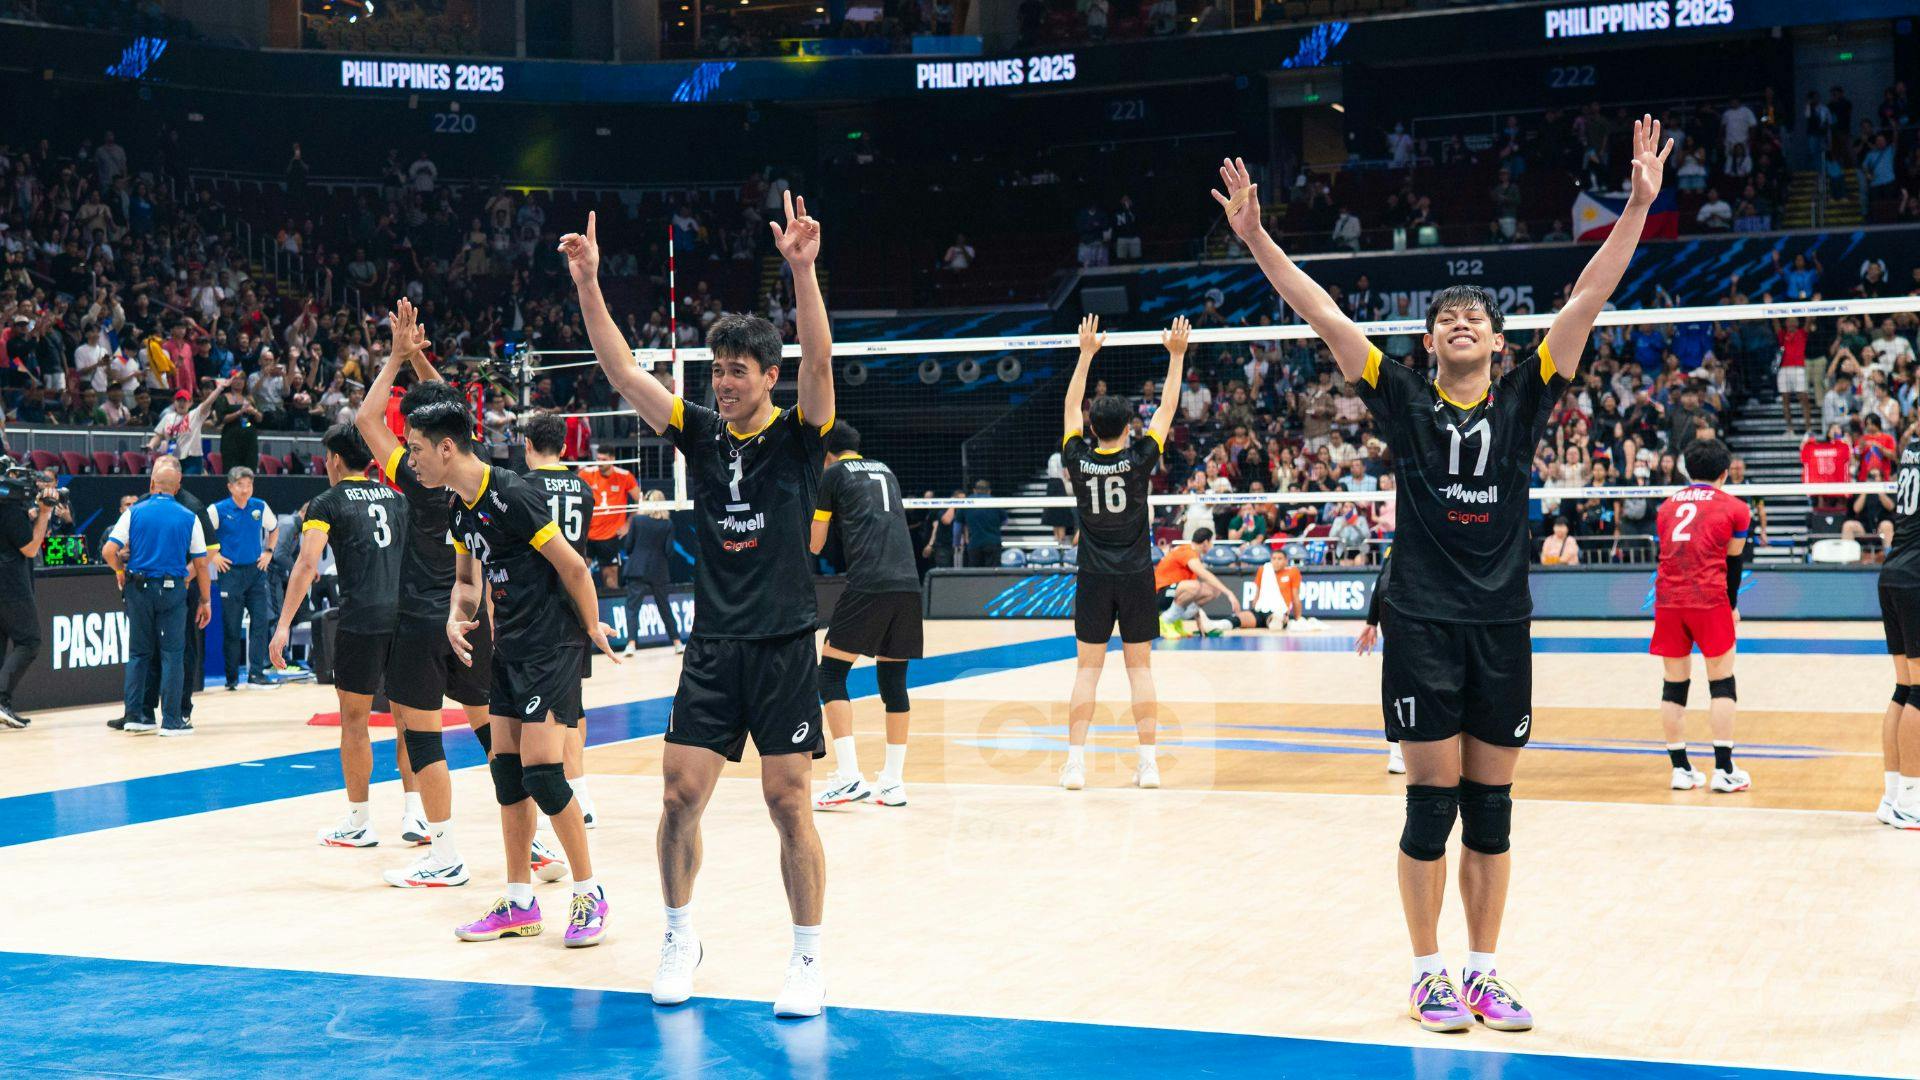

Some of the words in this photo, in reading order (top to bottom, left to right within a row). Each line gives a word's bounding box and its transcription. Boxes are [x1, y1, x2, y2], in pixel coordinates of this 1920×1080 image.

[1546, 1, 1670, 38] PHILIPPINES
[1675, 0, 1734, 27] 2025
[342, 60, 450, 90] PHILIPPINES
[455, 64, 504, 92] 2025
[917, 58, 1024, 89] PHILIPPINES
[1028, 53, 1076, 83] 2025
[1551, 65, 1595, 88] 222
[434, 113, 476, 133] 220
[1111, 100, 1144, 120] 221
[1446, 259, 1484, 276] 122
[1446, 418, 1491, 476] 17
[544, 477, 582, 493] ESPEJO
[868, 472, 890, 512] 7
[1085, 475, 1127, 514] 16
[367, 503, 392, 549] 3
[546, 494, 583, 542] 15
[1671, 502, 1698, 542] 2
[53, 611, 130, 670] PASAY
[1393, 696, 1416, 728] 17
